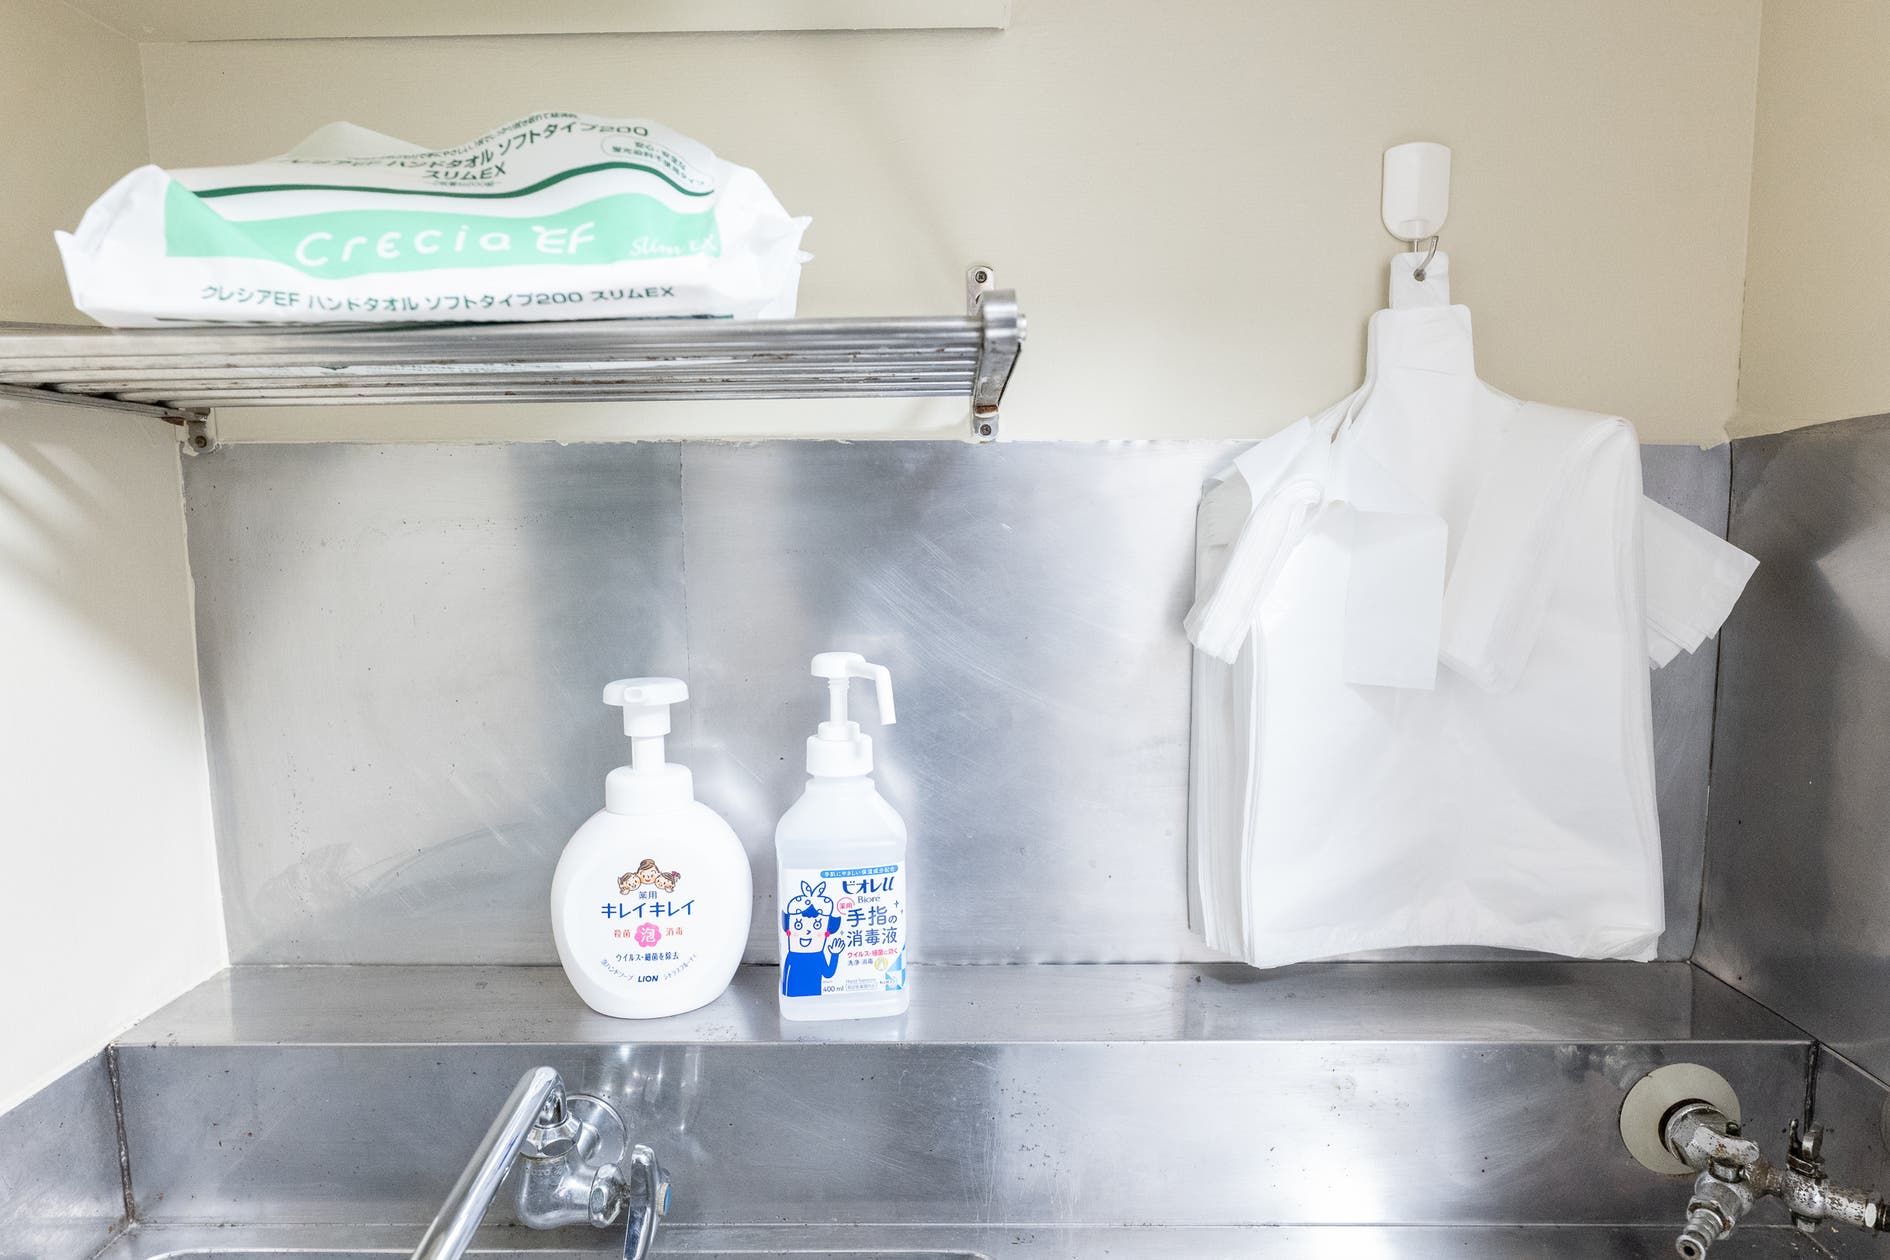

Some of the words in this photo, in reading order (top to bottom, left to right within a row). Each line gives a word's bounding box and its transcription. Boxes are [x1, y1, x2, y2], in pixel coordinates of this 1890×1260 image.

[424, 162, 507, 180] スリムEX
[295, 225, 511, 268] Crecia
[531, 222, 596, 255] EF
[201, 286, 300, 306] クレシアEF
[308, 296, 419, 311] ハンドタオル
[425, 291, 584, 310] ソフトタイプ200
[591, 286, 676, 300] スリムEX
[639, 891, 658, 900] 薬用
[601, 899, 695, 919] キレイキレイ
[846, 906, 898, 928] 手指の
[640, 927, 656, 943] 泡
[846, 926, 898, 948] 消毒液
[637, 975, 659, 983] LION
